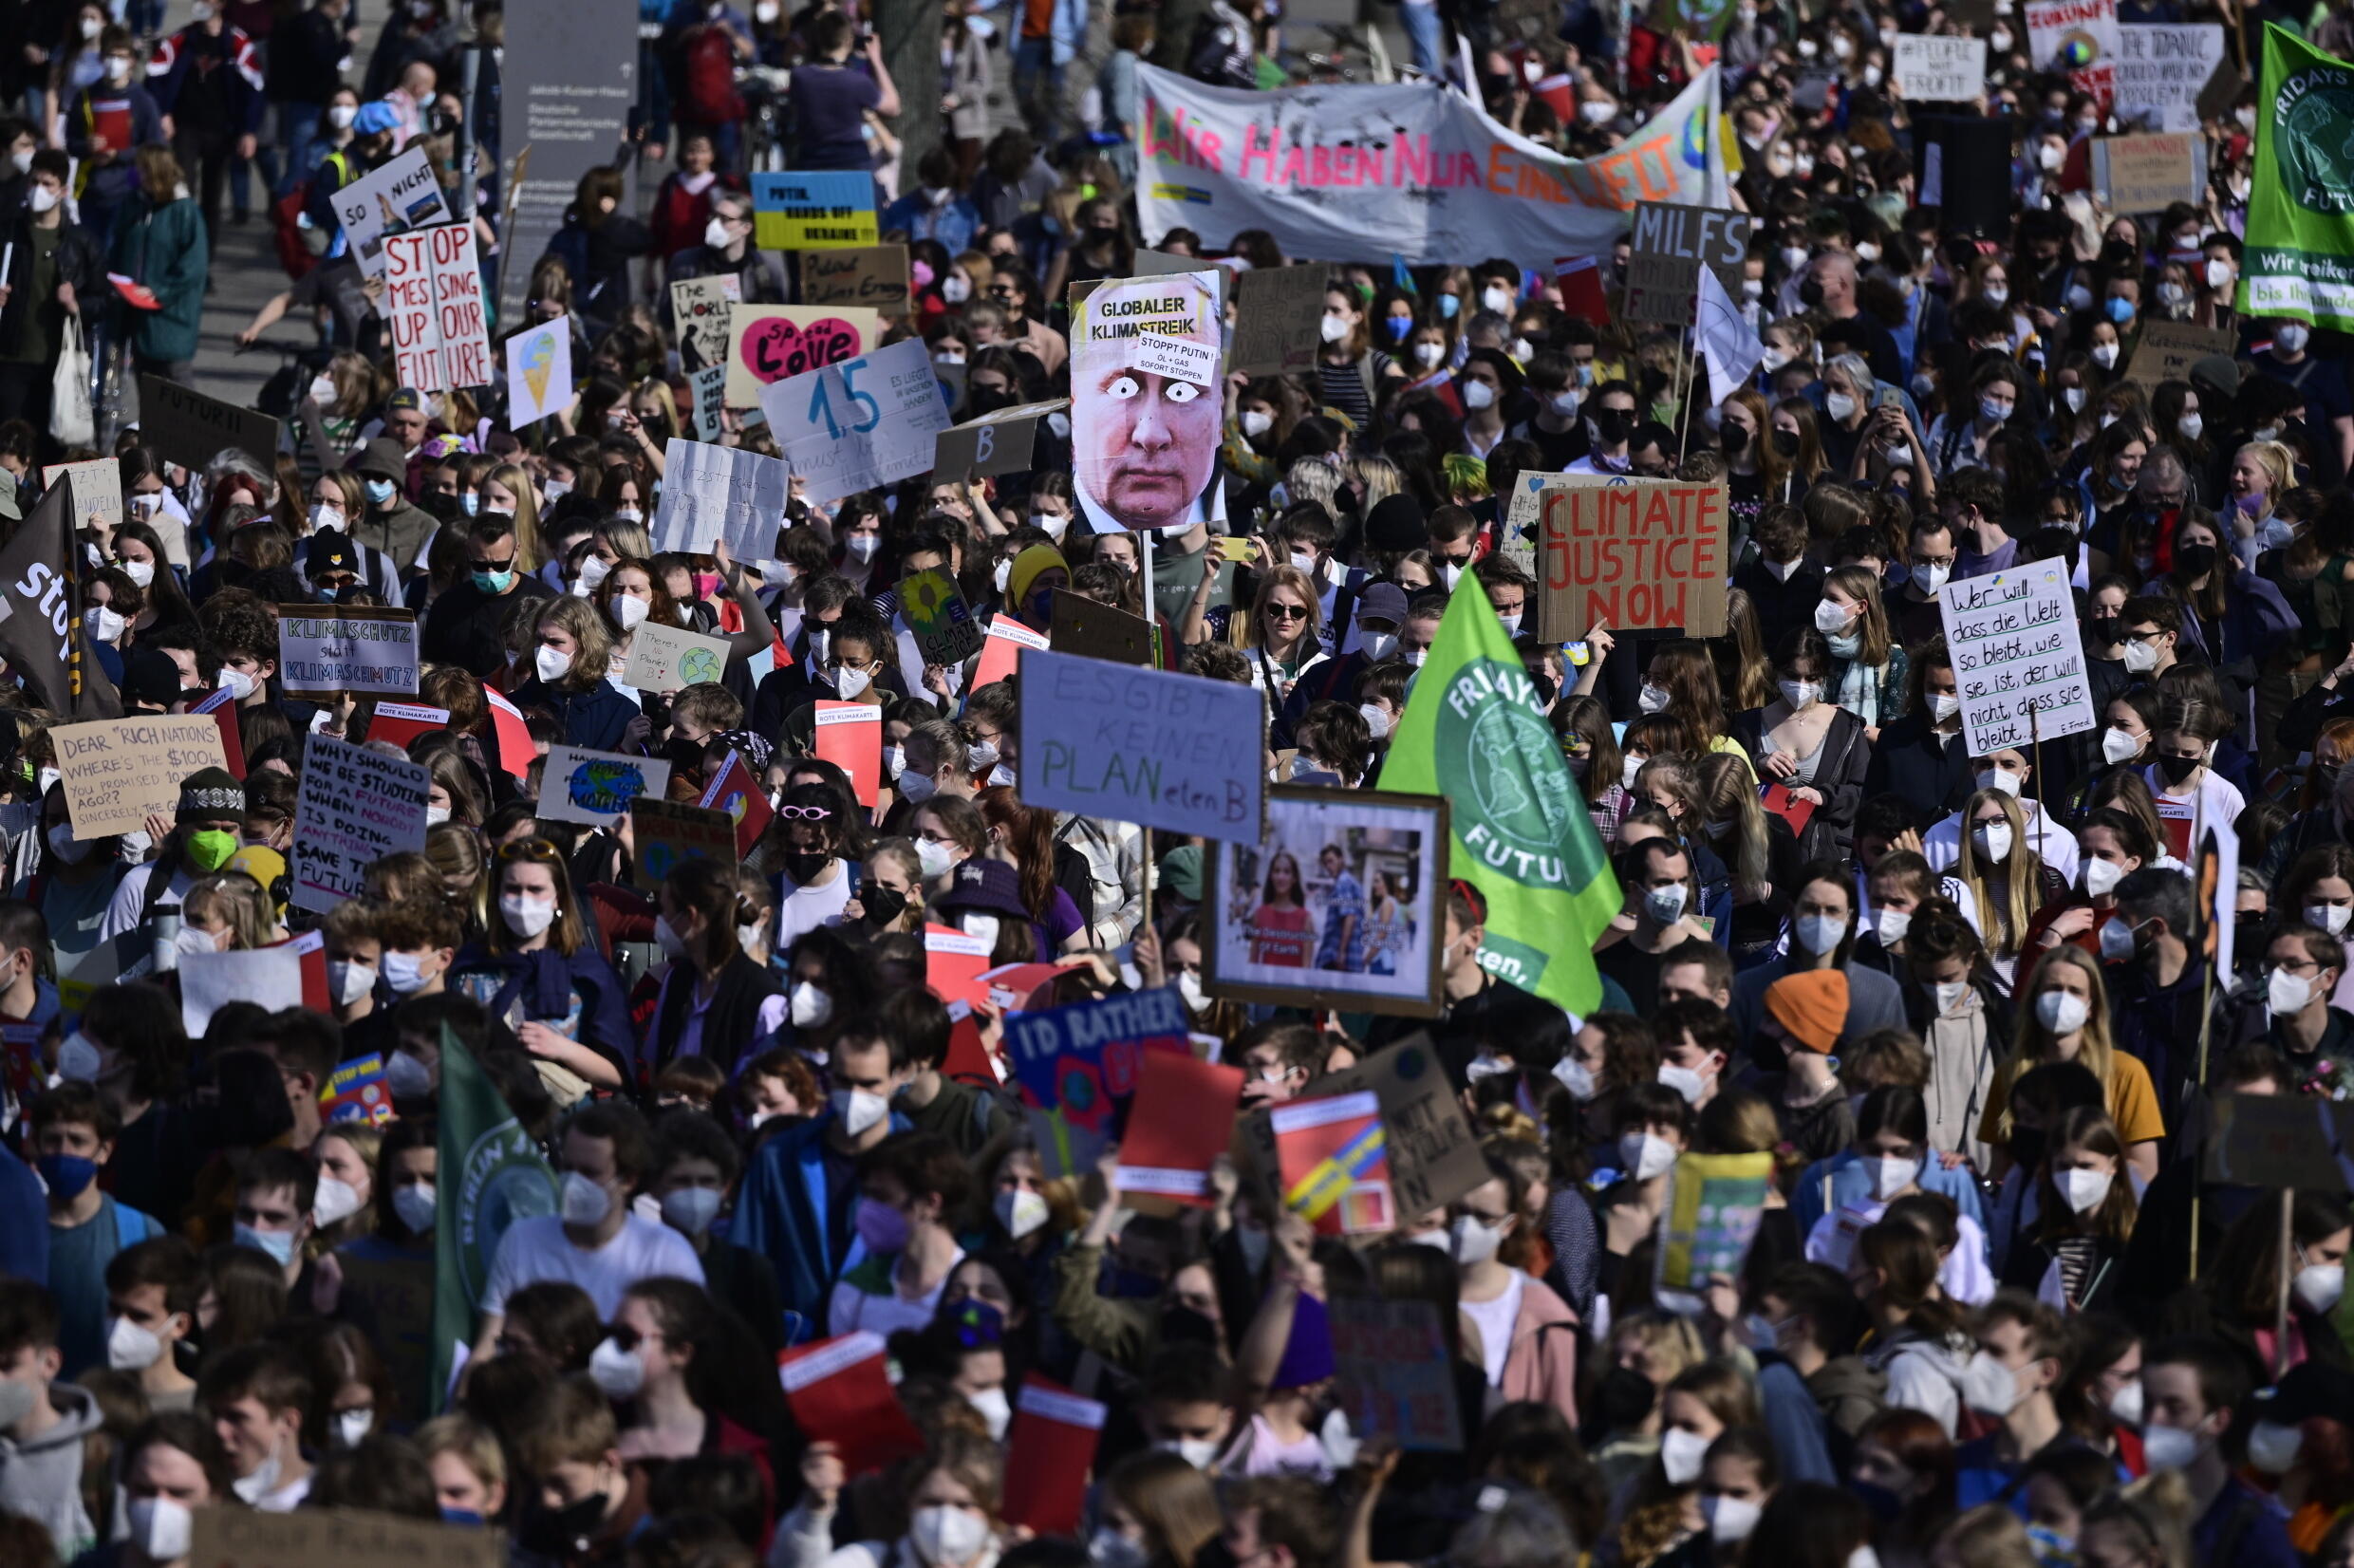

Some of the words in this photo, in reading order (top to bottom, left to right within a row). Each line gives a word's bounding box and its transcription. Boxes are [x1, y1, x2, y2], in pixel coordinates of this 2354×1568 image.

[2275, 68, 2347, 127] FRIDAYS
[391, 164, 432, 200] NICHT
[346, 204, 366, 226] SO
[1635, 205, 1747, 264] MILFS
[386, 227, 469, 276] STOP
[2261, 253, 2294, 272] Wir
[389, 271, 478, 308] MESSING
[674, 285, 704, 298] The
[2256, 283, 2283, 302] bis
[1101, 297, 1186, 317] GLOBALER
[393, 312, 427, 348] UP
[440, 302, 484, 340] OUR
[1092, 318, 1195, 341] KLIMASTREIK
[1141, 336, 1180, 355] STOPPT
[1181, 345, 1209, 361] PUTIN
[1174, 358, 1190, 367] GAS
[397, 342, 488, 391] FUTURE
[1140, 360, 1169, 373] SOFORT
[1170, 366, 1202, 380] STOPPEN
[975, 424, 994, 463] B
[75, 495, 121, 515] ANDELN
[1545, 488, 1719, 539] CLIMATE
[1547, 537, 1717, 590] JUSTICE
[1586, 583, 1686, 630] NOW
[1950, 585, 1994, 611] Wer
[2003, 579, 2033, 600] will,
[15, 562, 69, 663] sto
[1952, 622, 1987, 643] dass
[1993, 613, 2019, 632] die
[2025, 600, 2062, 625] Welt
[287, 619, 411, 643] KLIMASCHUTZ
[993, 627, 1008, 637] ROTE
[1009, 631, 1043, 647] KLIMAKARTE
[320, 643, 355, 659] statt
[1959, 654, 1976, 671] so
[1983, 637, 2031, 664] bleibt,
[2035, 633, 2062, 652] wie
[285, 662, 414, 687] KLIMASCHMUTZ
[1965, 681, 1987, 700] sie
[1994, 670, 2019, 691] ist,
[2023, 664, 2048, 685] der
[2055, 656, 2077, 677] will
[1054, 664, 1115, 705] ES
[1125, 674, 1224, 722] GIBT
[1970, 701, 2010, 727] nicht,
[2017, 692, 2054, 716] dass
[2059, 685, 2083, 705] sie
[398, 710, 439, 720] KLIMAKARTE
[837, 712, 873, 720] KLIMAKARTE
[63, 735, 113, 759] DEAR
[1094, 716, 1246, 769] KEINEN
[65, 756, 134, 780] WHERE'S
[138, 754, 164, 766] THE
[309, 757, 332, 775] WE
[337, 766, 357, 783] BE
[312, 741, 353, 761] WHY
[356, 754, 423, 782] SHOULD
[70, 784, 95, 798] YOU
[101, 774, 159, 791] PROMISED
[166, 771, 180, 784] 10
[78, 790, 120, 810] AGO??
[306, 775, 332, 792] FOR
[338, 787, 350, 798] A
[355, 790, 419, 818] FUTURE
[142, 802, 164, 814] THE
[306, 790, 355, 814] WHEN
[1223, 779, 1248, 823] B
[302, 825, 370, 856] ANYTHING
[304, 806, 326, 825] IS
[334, 820, 392, 846] DOING
[296, 840, 340, 868] SAVE
[1465, 823, 1572, 887] FUTU
[300, 863, 366, 896] FUTUR
[1017, 1017, 1060, 1060] I'D
[1065, 990, 1186, 1051] RATHER
[333, 1067, 358, 1084] STOP
